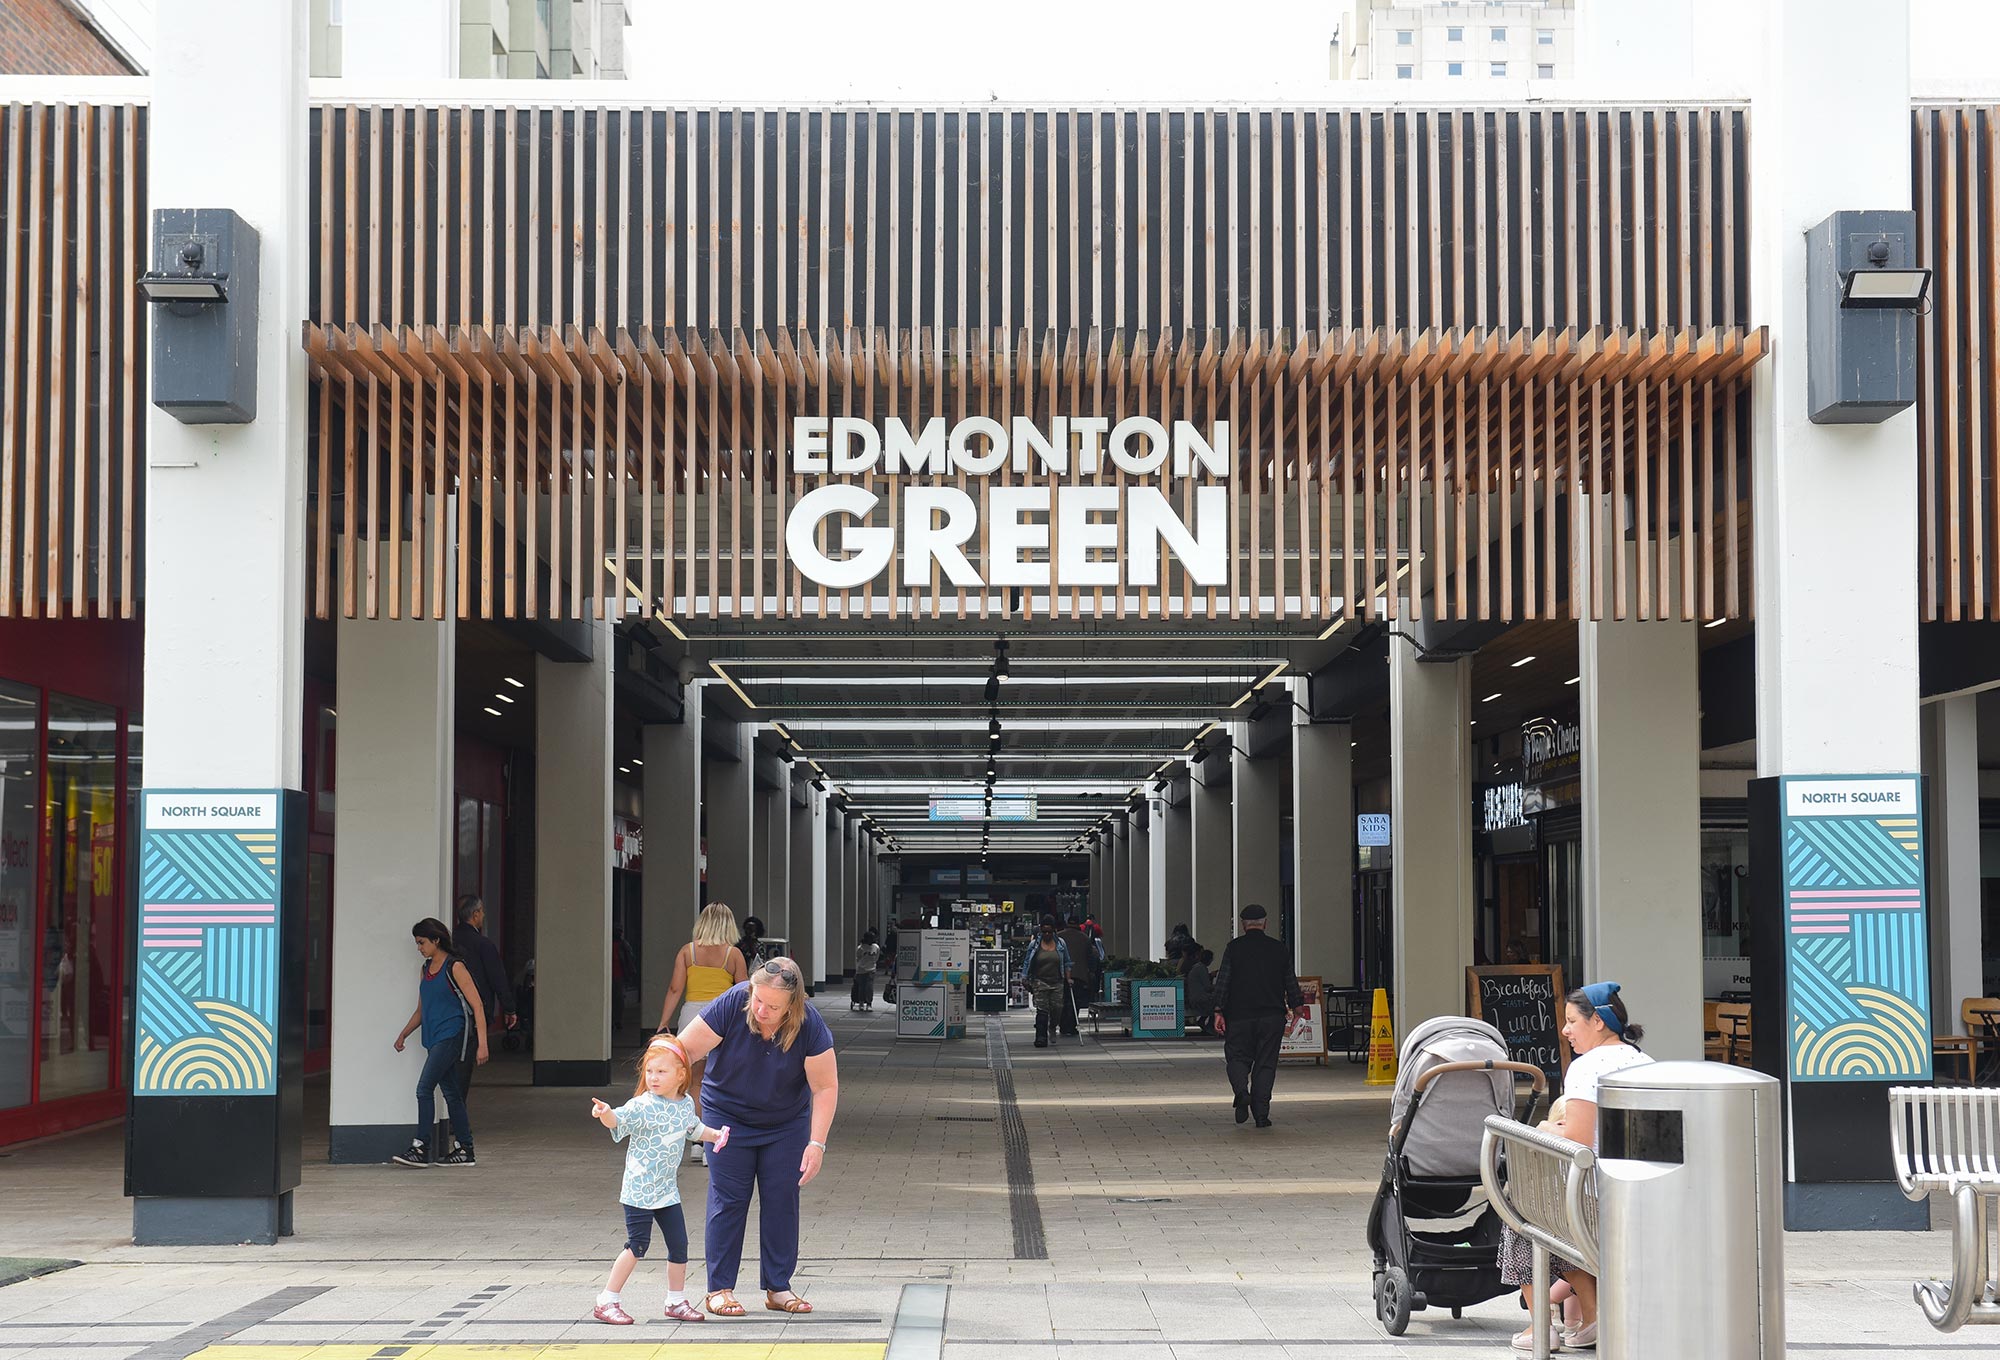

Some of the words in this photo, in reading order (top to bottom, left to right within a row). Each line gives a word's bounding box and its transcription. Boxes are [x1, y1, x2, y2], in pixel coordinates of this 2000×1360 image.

[793, 416, 1230, 477] EDMONTON
[785, 484, 1228, 588] GREEN
[1557, 722, 1580, 756] Choice
[1802, 792, 1847, 804] NORTH
[1851, 792, 1901, 803] SQUARE
[161, 806, 207, 817] NORTH
[211, 806, 261, 817] SQUARE
[1361, 816, 1387, 824] SARA
[1362, 824, 1386, 832] KIDS
[1481, 976, 1553, 1005] Breakfast
[902, 1007, 939, 1017] GREEN
[1492, 1000, 1555, 1033] Lunch
[1508, 1046, 1560, 1068] inner
